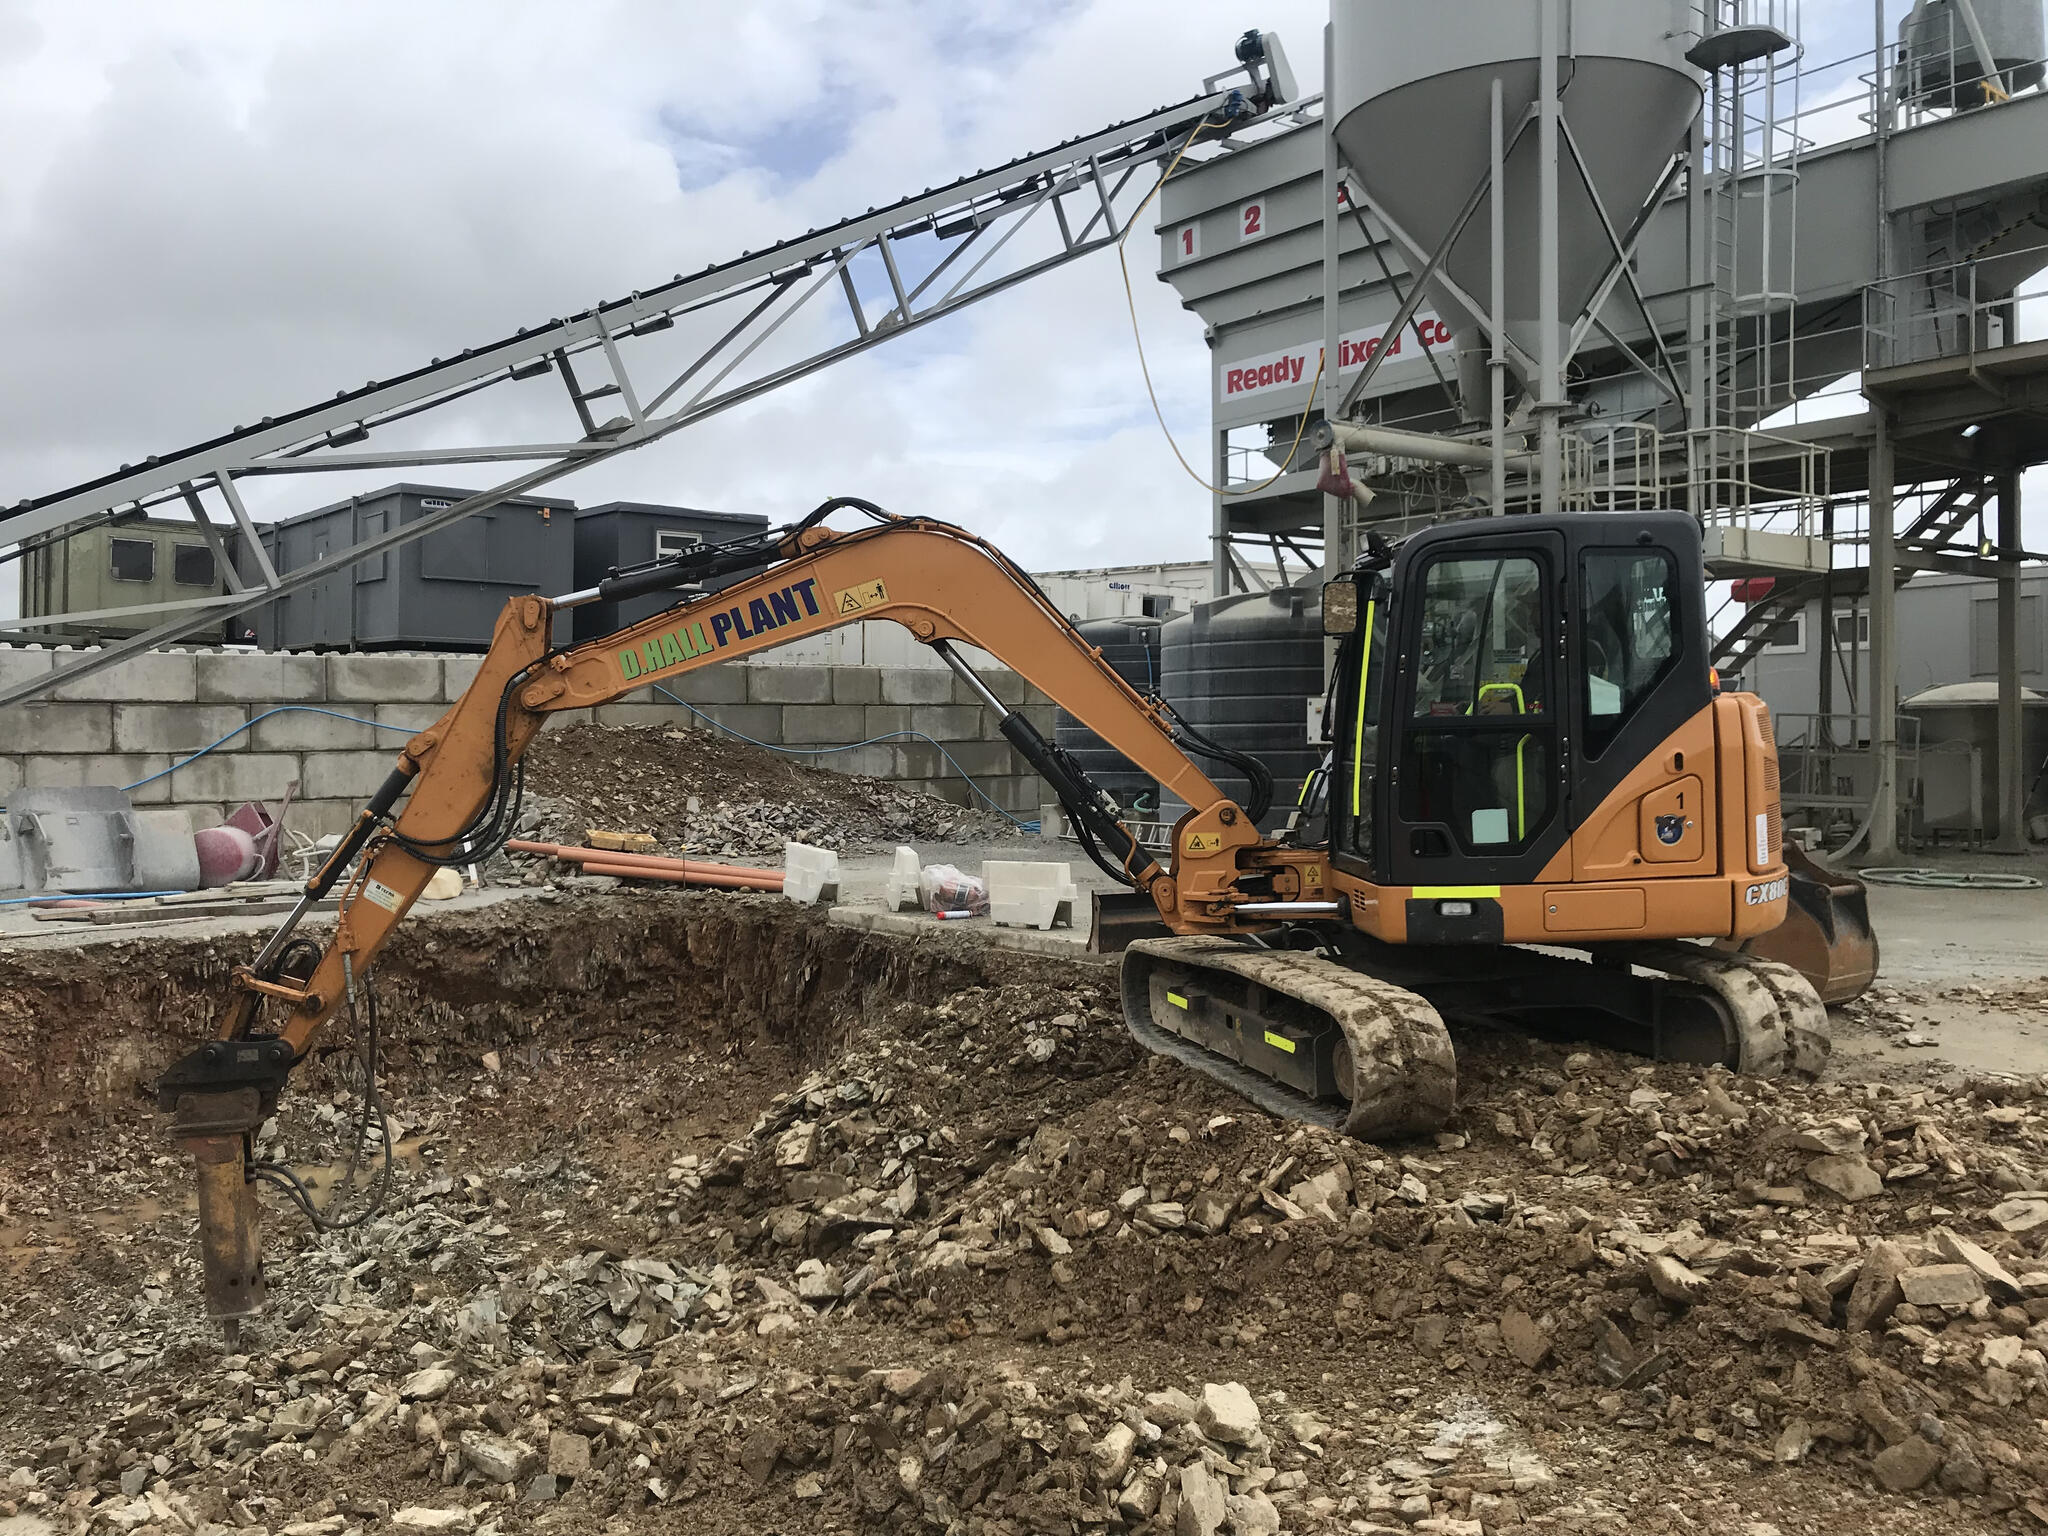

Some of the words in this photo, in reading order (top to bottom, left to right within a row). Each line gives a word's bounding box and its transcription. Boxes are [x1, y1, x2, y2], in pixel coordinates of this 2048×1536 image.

[1245, 205, 1261, 235] 2
[1183, 228, 1193, 255] 1
[1227, 355, 1305, 394] Ready
[1320, 334, 1401, 372] ixe
[618, 622, 715, 681] D.HALL
[710, 577, 821, 647] PLANT
[1676, 792, 1684, 810] 1
